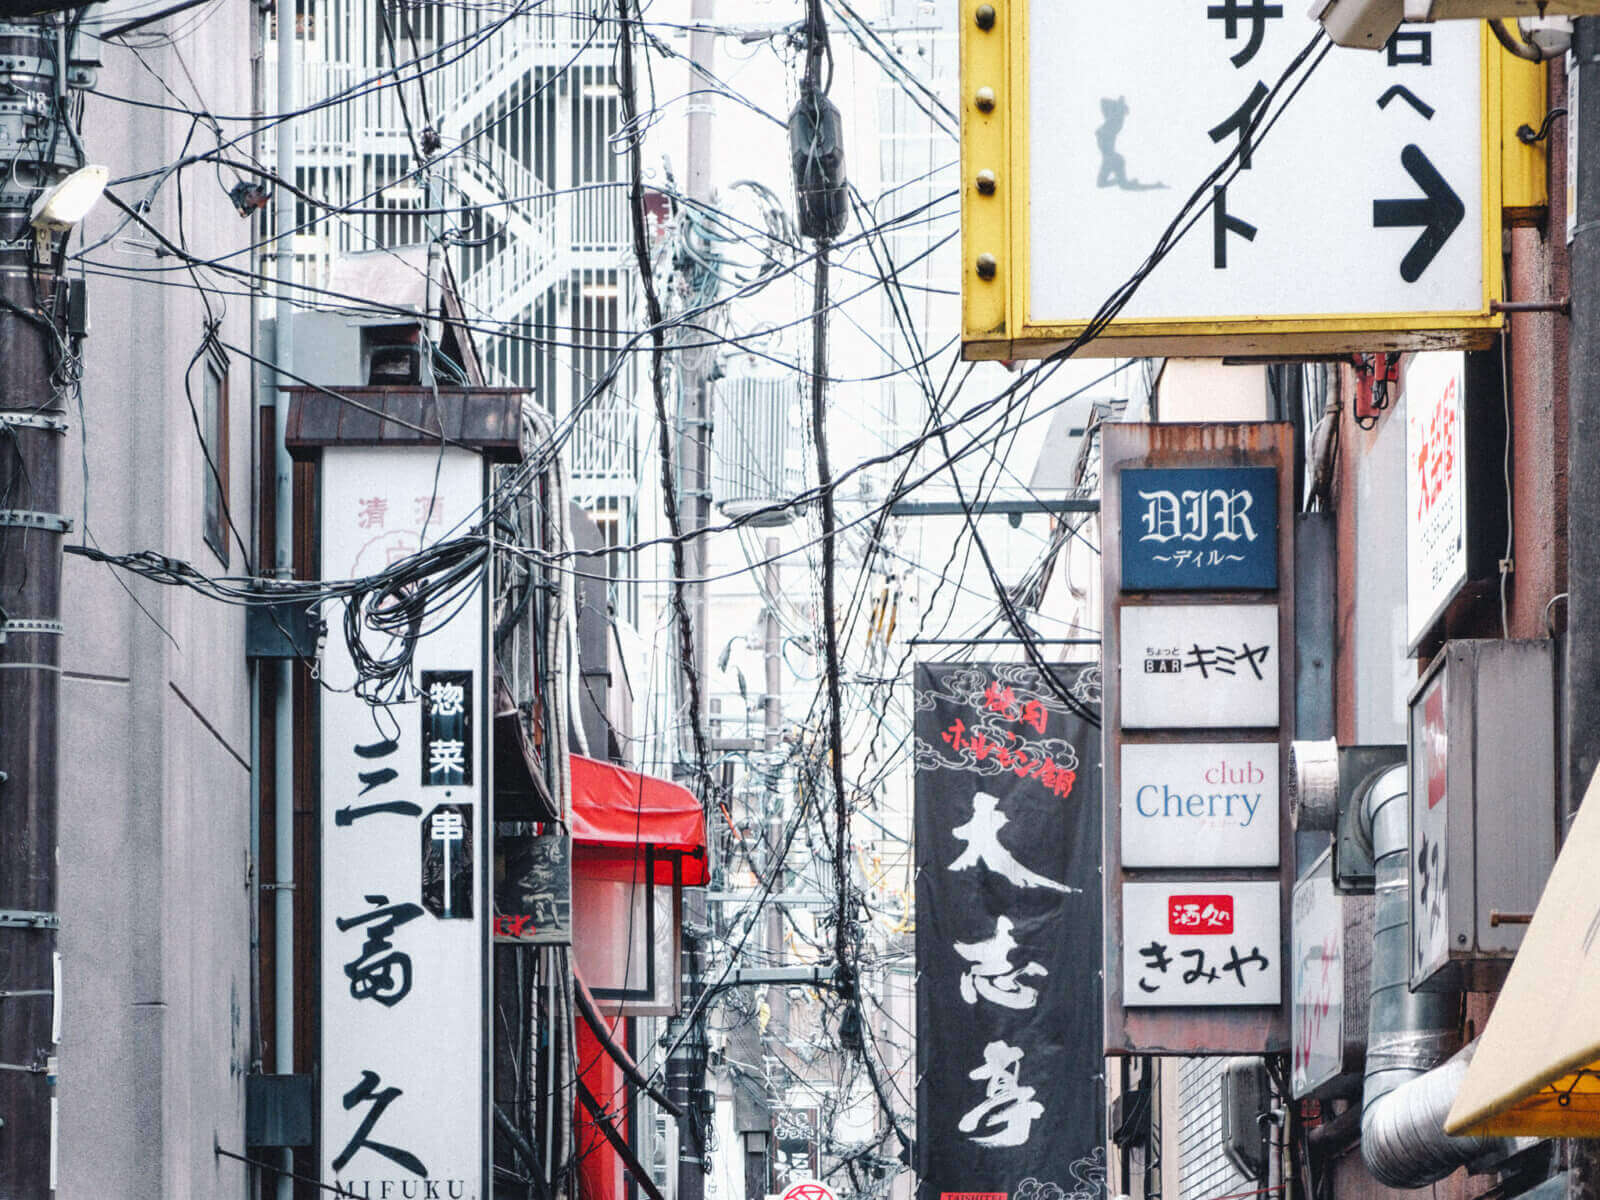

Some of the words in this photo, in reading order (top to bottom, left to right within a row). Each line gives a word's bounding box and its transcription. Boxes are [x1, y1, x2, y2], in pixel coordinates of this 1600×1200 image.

[1208, 0, 1283, 269] サイト
[358, 496, 444, 528] 清酒
[1138, 488, 1258, 543] DIR
[1146, 647, 1180, 656] ちょっと
[1146, 660, 1180, 672] BAR
[1184, 643, 1270, 681] キミヤ
[984, 681, 1048, 735] 焼肉
[942, 718, 1076, 798] ホルモン鍋
[1205, 761, 1264, 784] club
[1136, 784, 1261, 827] Cherry
[1172, 903, 1231, 926] 酒処
[332, 739, 428, 1178] 三富久
[947, 791, 1082, 1147] 大志亭
[1138, 942, 1269, 993] きみや
[335, 1180, 465, 1200] MIFUKU
